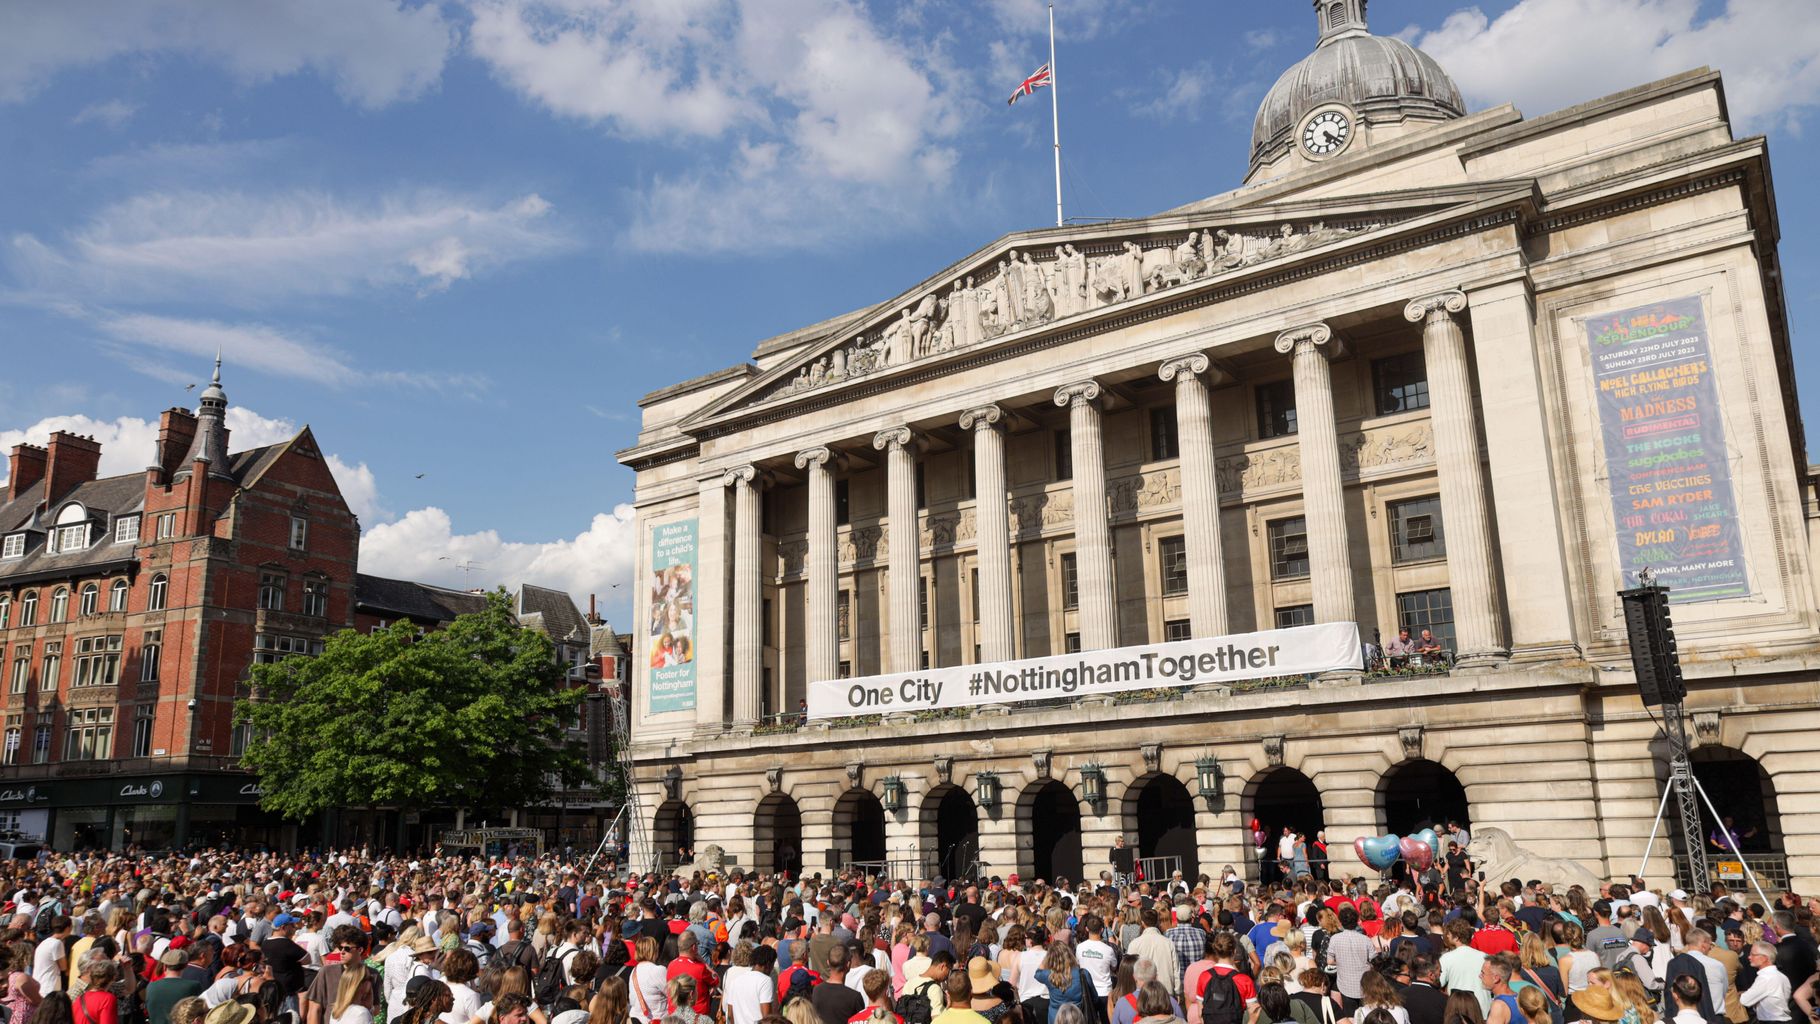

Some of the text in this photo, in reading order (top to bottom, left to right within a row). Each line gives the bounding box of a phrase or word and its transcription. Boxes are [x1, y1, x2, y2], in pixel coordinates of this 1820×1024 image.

[1602, 320, 1689, 345] SPLENDOUR
[1600, 336, 1699, 361] SATURDAY 22ND JULY 2023
[1605, 346, 1695, 370] SUNDAY 23RD JULY 2023
[1600, 376, 1629, 392] NOEL
[1615, 374, 1699, 399] HIGH FLYING BIRDS
[1620, 396, 1697, 422] MADNESS
[1626, 418, 1697, 436] RUDIMENTAL
[1626, 434, 1701, 454] THE KOOKS
[1628, 448, 1705, 468] sugababes
[1632, 490, 1713, 511] SAM RYDER
[1622, 514, 1645, 528] THE
[662, 526, 682, 536] Make
[1635, 529, 1675, 546] DYLAN
[658, 534, 692, 547] difference
[657, 550, 664, 558] to
[672, 544, 694, 555] child's
[1655, 566, 1680, 576] MANY,
[1682, 563, 1706, 572] MANY
[1708, 560, 1734, 569] MORE
[656, 669, 690, 680] Foster for
[848, 644, 1280, 707] One City #NottinghamTogether
[652, 679, 693, 692] Nottingham
[120, 784, 148, 796] Clarks
